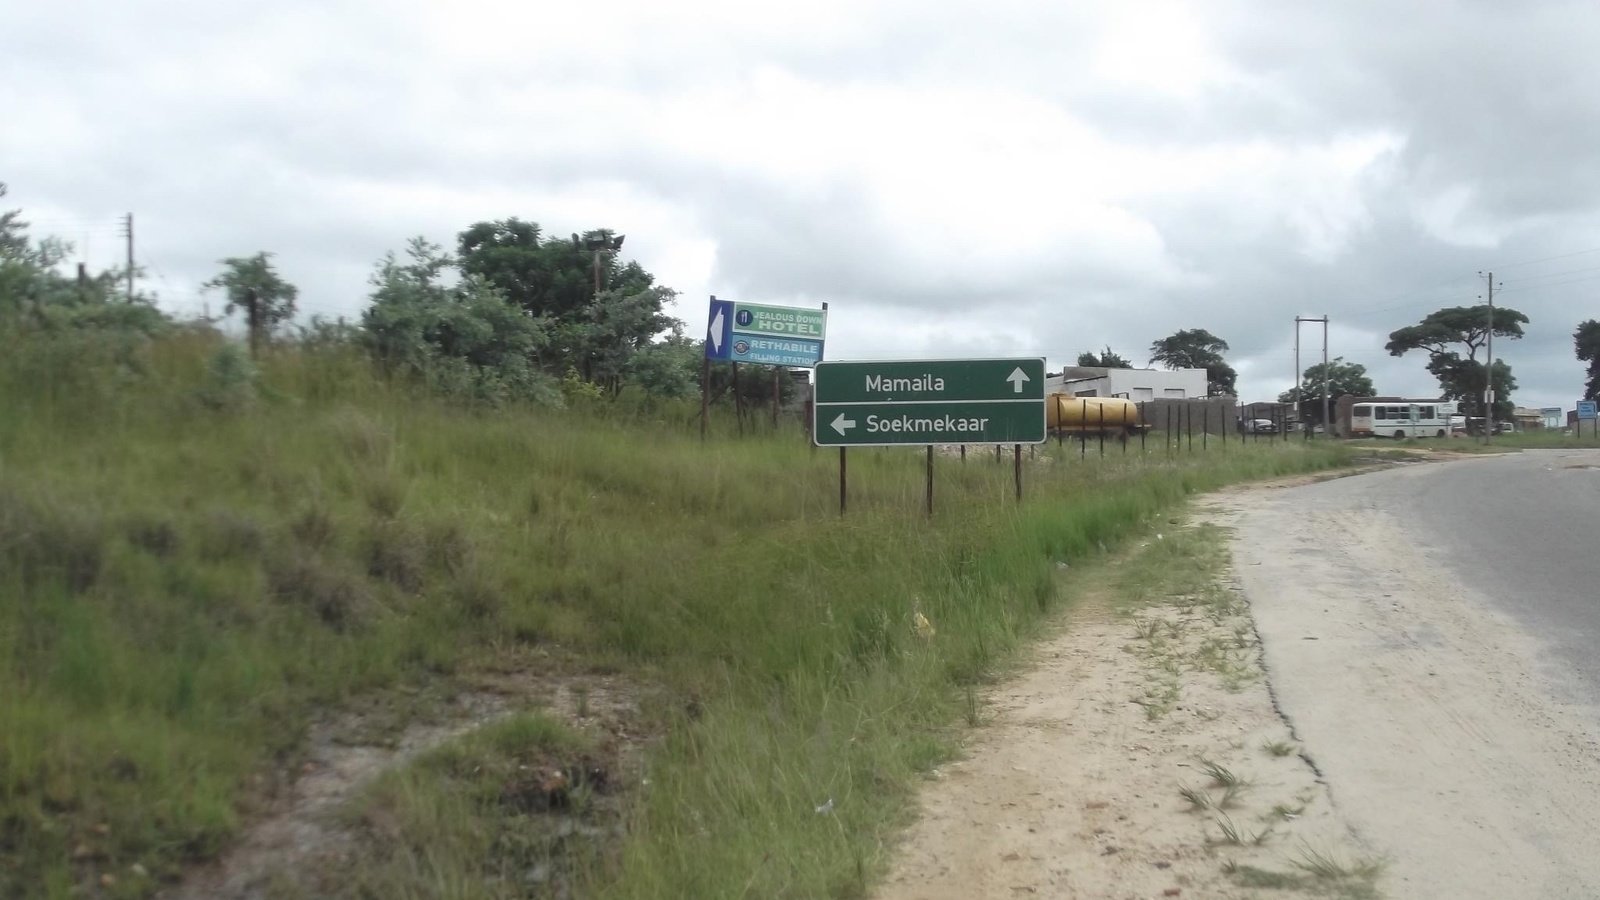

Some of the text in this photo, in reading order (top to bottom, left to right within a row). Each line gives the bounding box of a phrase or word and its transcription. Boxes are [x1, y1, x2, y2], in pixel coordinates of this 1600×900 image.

[754, 311, 794, 321] JEALOUS
[758, 321, 819, 334] HOTEL
[750, 340, 818, 353] RETHABILE
[750, 353, 816, 365] FILLING STATION
[865, 373, 945, 392] Mamaila
[866, 414, 989, 433] Soekmekaar
